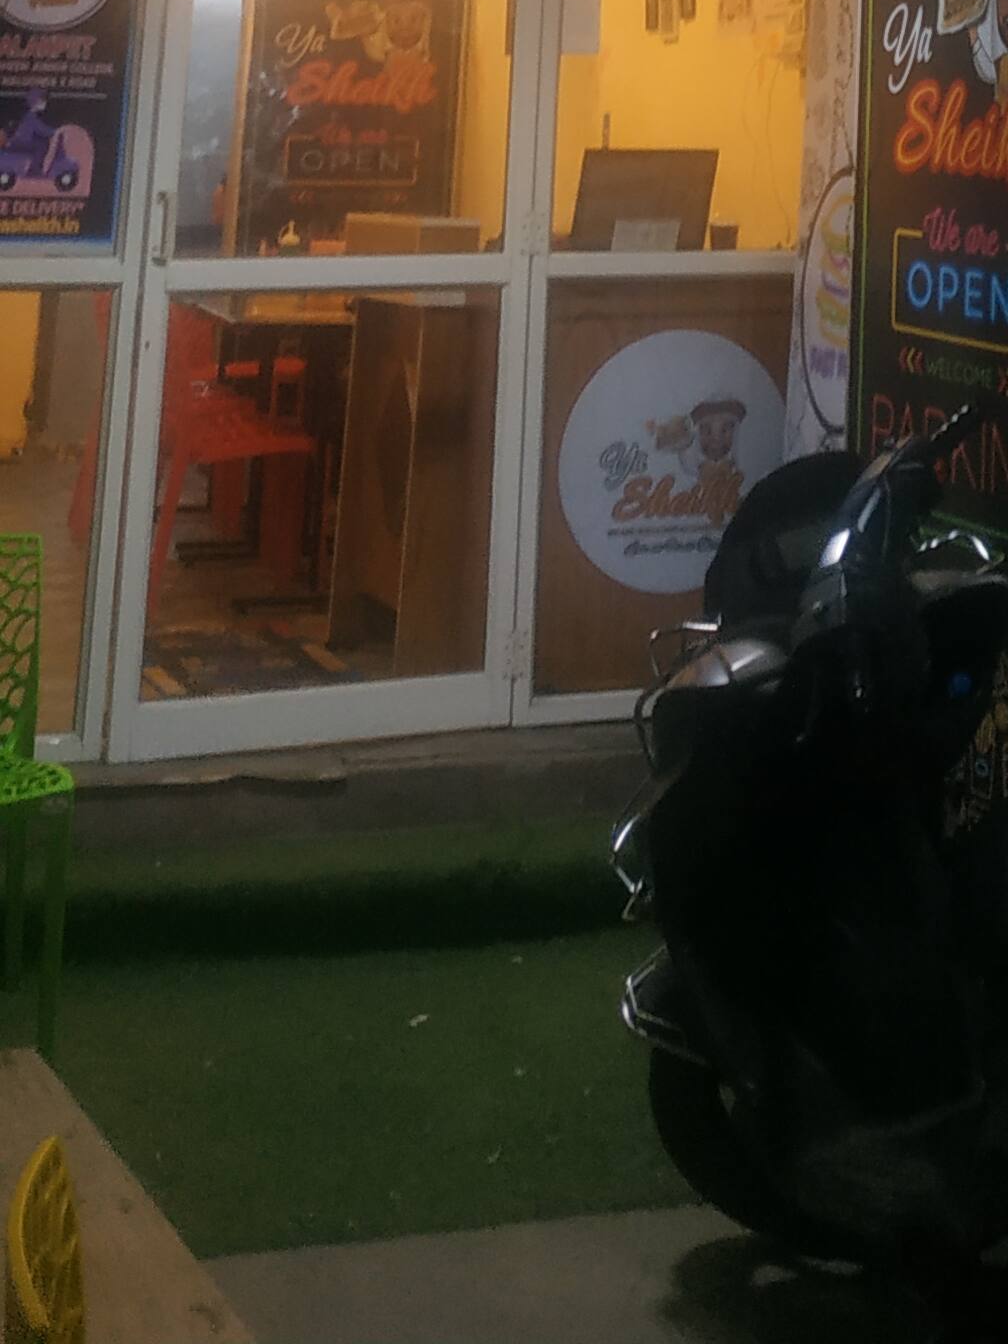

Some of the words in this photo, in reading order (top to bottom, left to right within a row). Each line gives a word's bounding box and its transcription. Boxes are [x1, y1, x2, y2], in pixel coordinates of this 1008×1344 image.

[883, 2, 933, 94] Ya
[923, 206, 961, 253] We
[964, 223, 1000, 257] are
[926, 357, 993, 389] WELCOME
